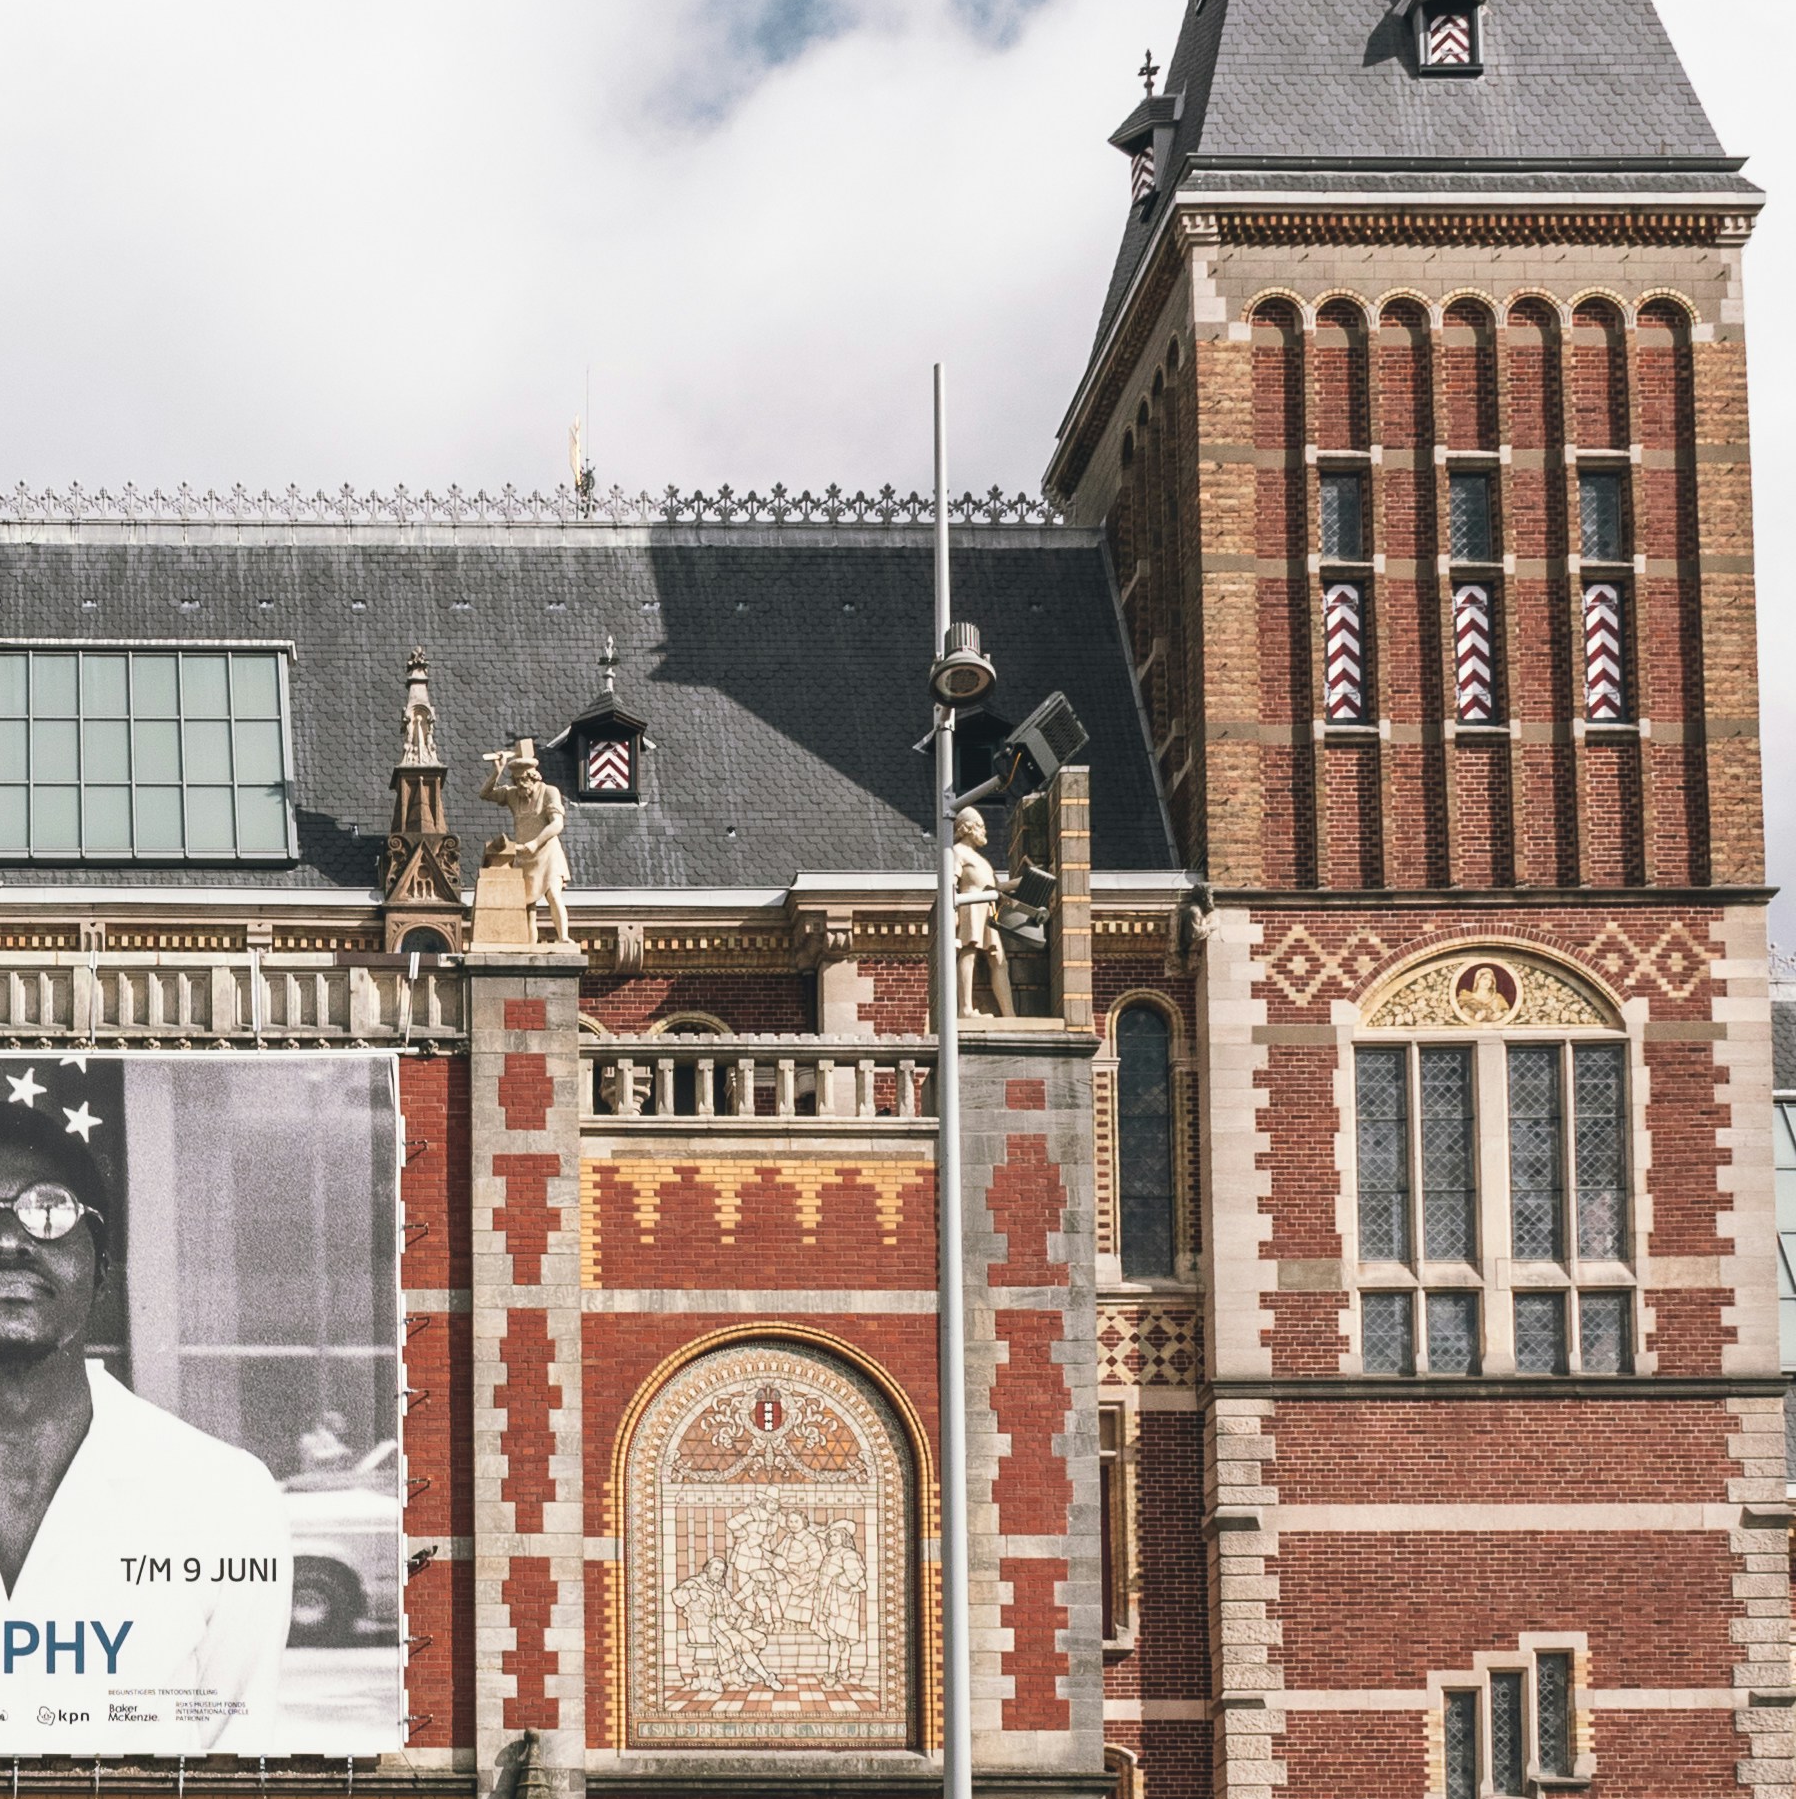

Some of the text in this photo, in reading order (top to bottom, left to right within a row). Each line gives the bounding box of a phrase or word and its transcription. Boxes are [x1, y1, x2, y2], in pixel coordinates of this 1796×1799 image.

[120, 1555, 277, 1585] T/M 9 JUNI
[109, 1703, 138, 1714] Baker
[58, 1709, 90, 1725] kpn
